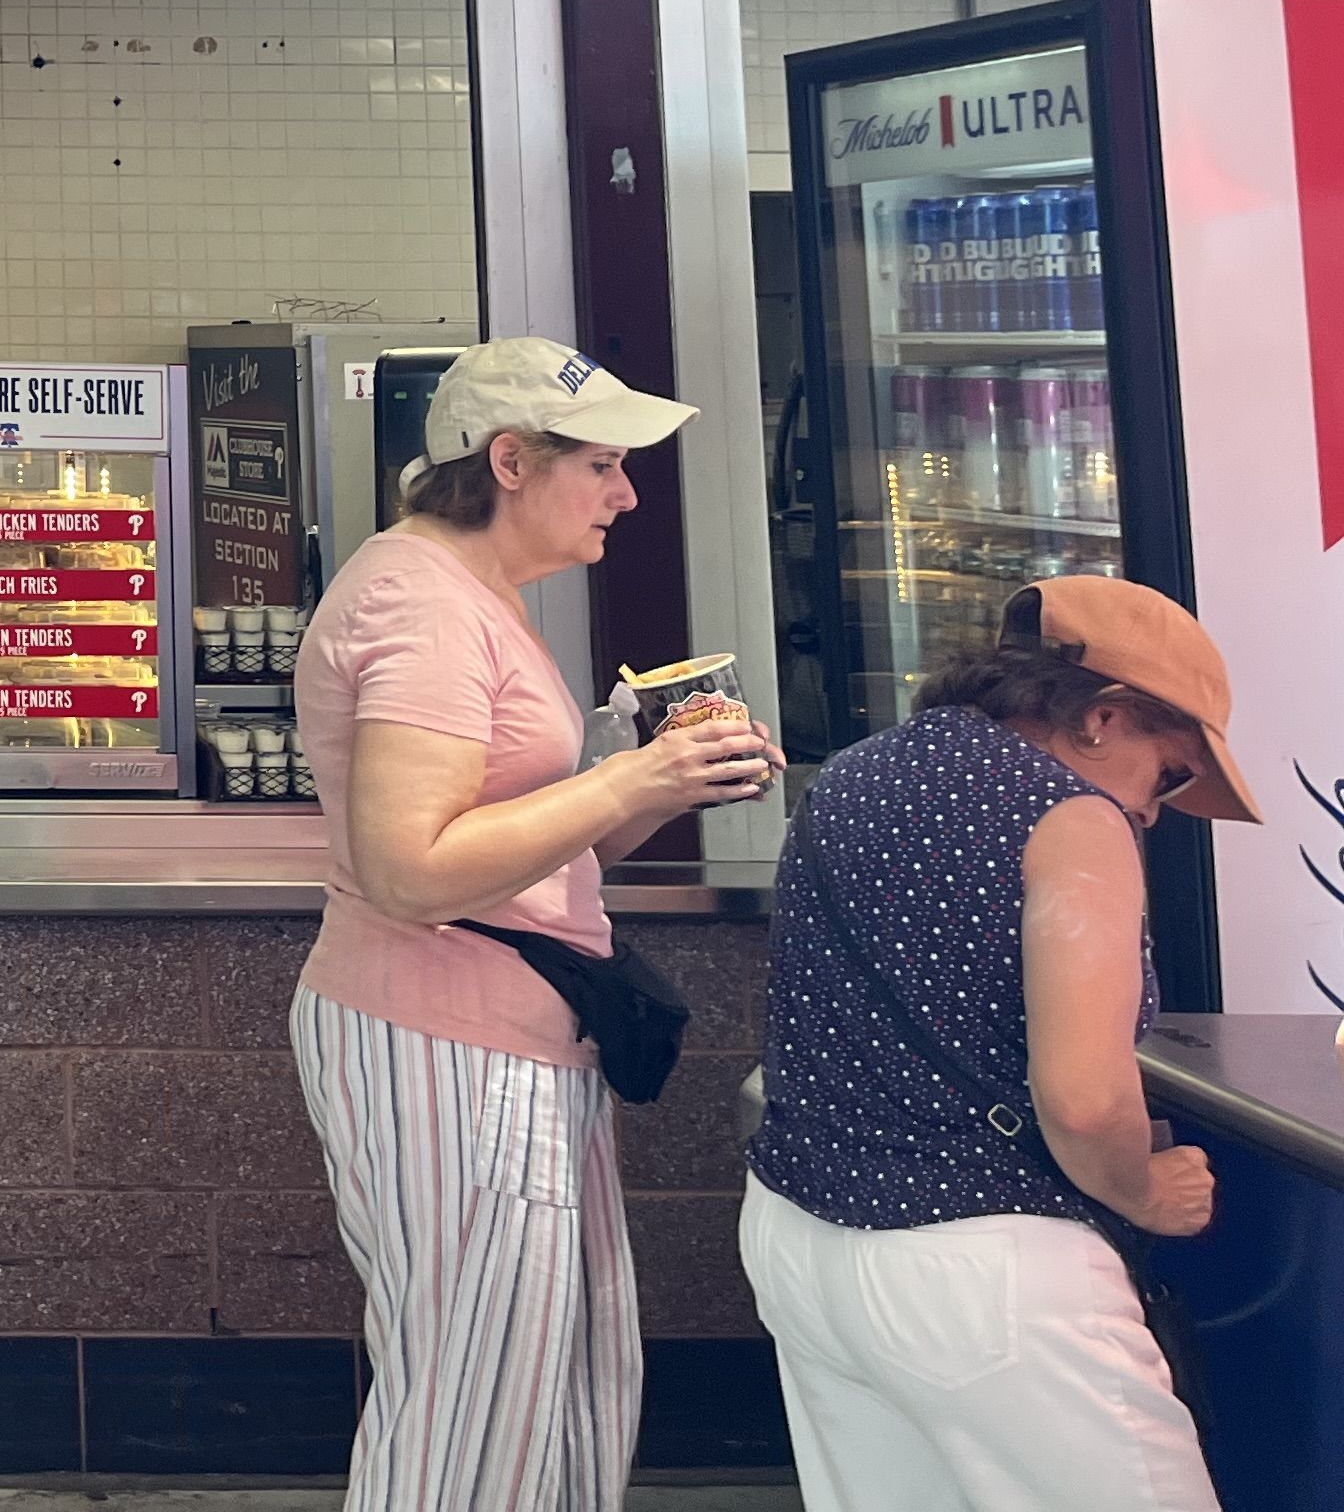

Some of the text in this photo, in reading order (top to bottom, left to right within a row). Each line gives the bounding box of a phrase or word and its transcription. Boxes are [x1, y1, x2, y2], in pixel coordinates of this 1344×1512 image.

[830, 85, 1083, 159] Michelob ULTRA
[202, 354, 260, 411] Visit the
[28, 378, 145, 416] SELF-SERVE
[43, 514, 100, 532] TENDERS
[202, 500, 291, 536] LOCATED AT
[4, 531, 24, 540] PIECE
[215, 539, 279, 571] SECTION
[21, 577, 58, 595] FRIES
[232, 575, 264, 607] 135
[14, 629, 72, 647] TENDERS
[7, 646, 28, 655] PIECE
[14, 690, 73, 708] TENDERS
[7, 707, 28, 716] PIECE
